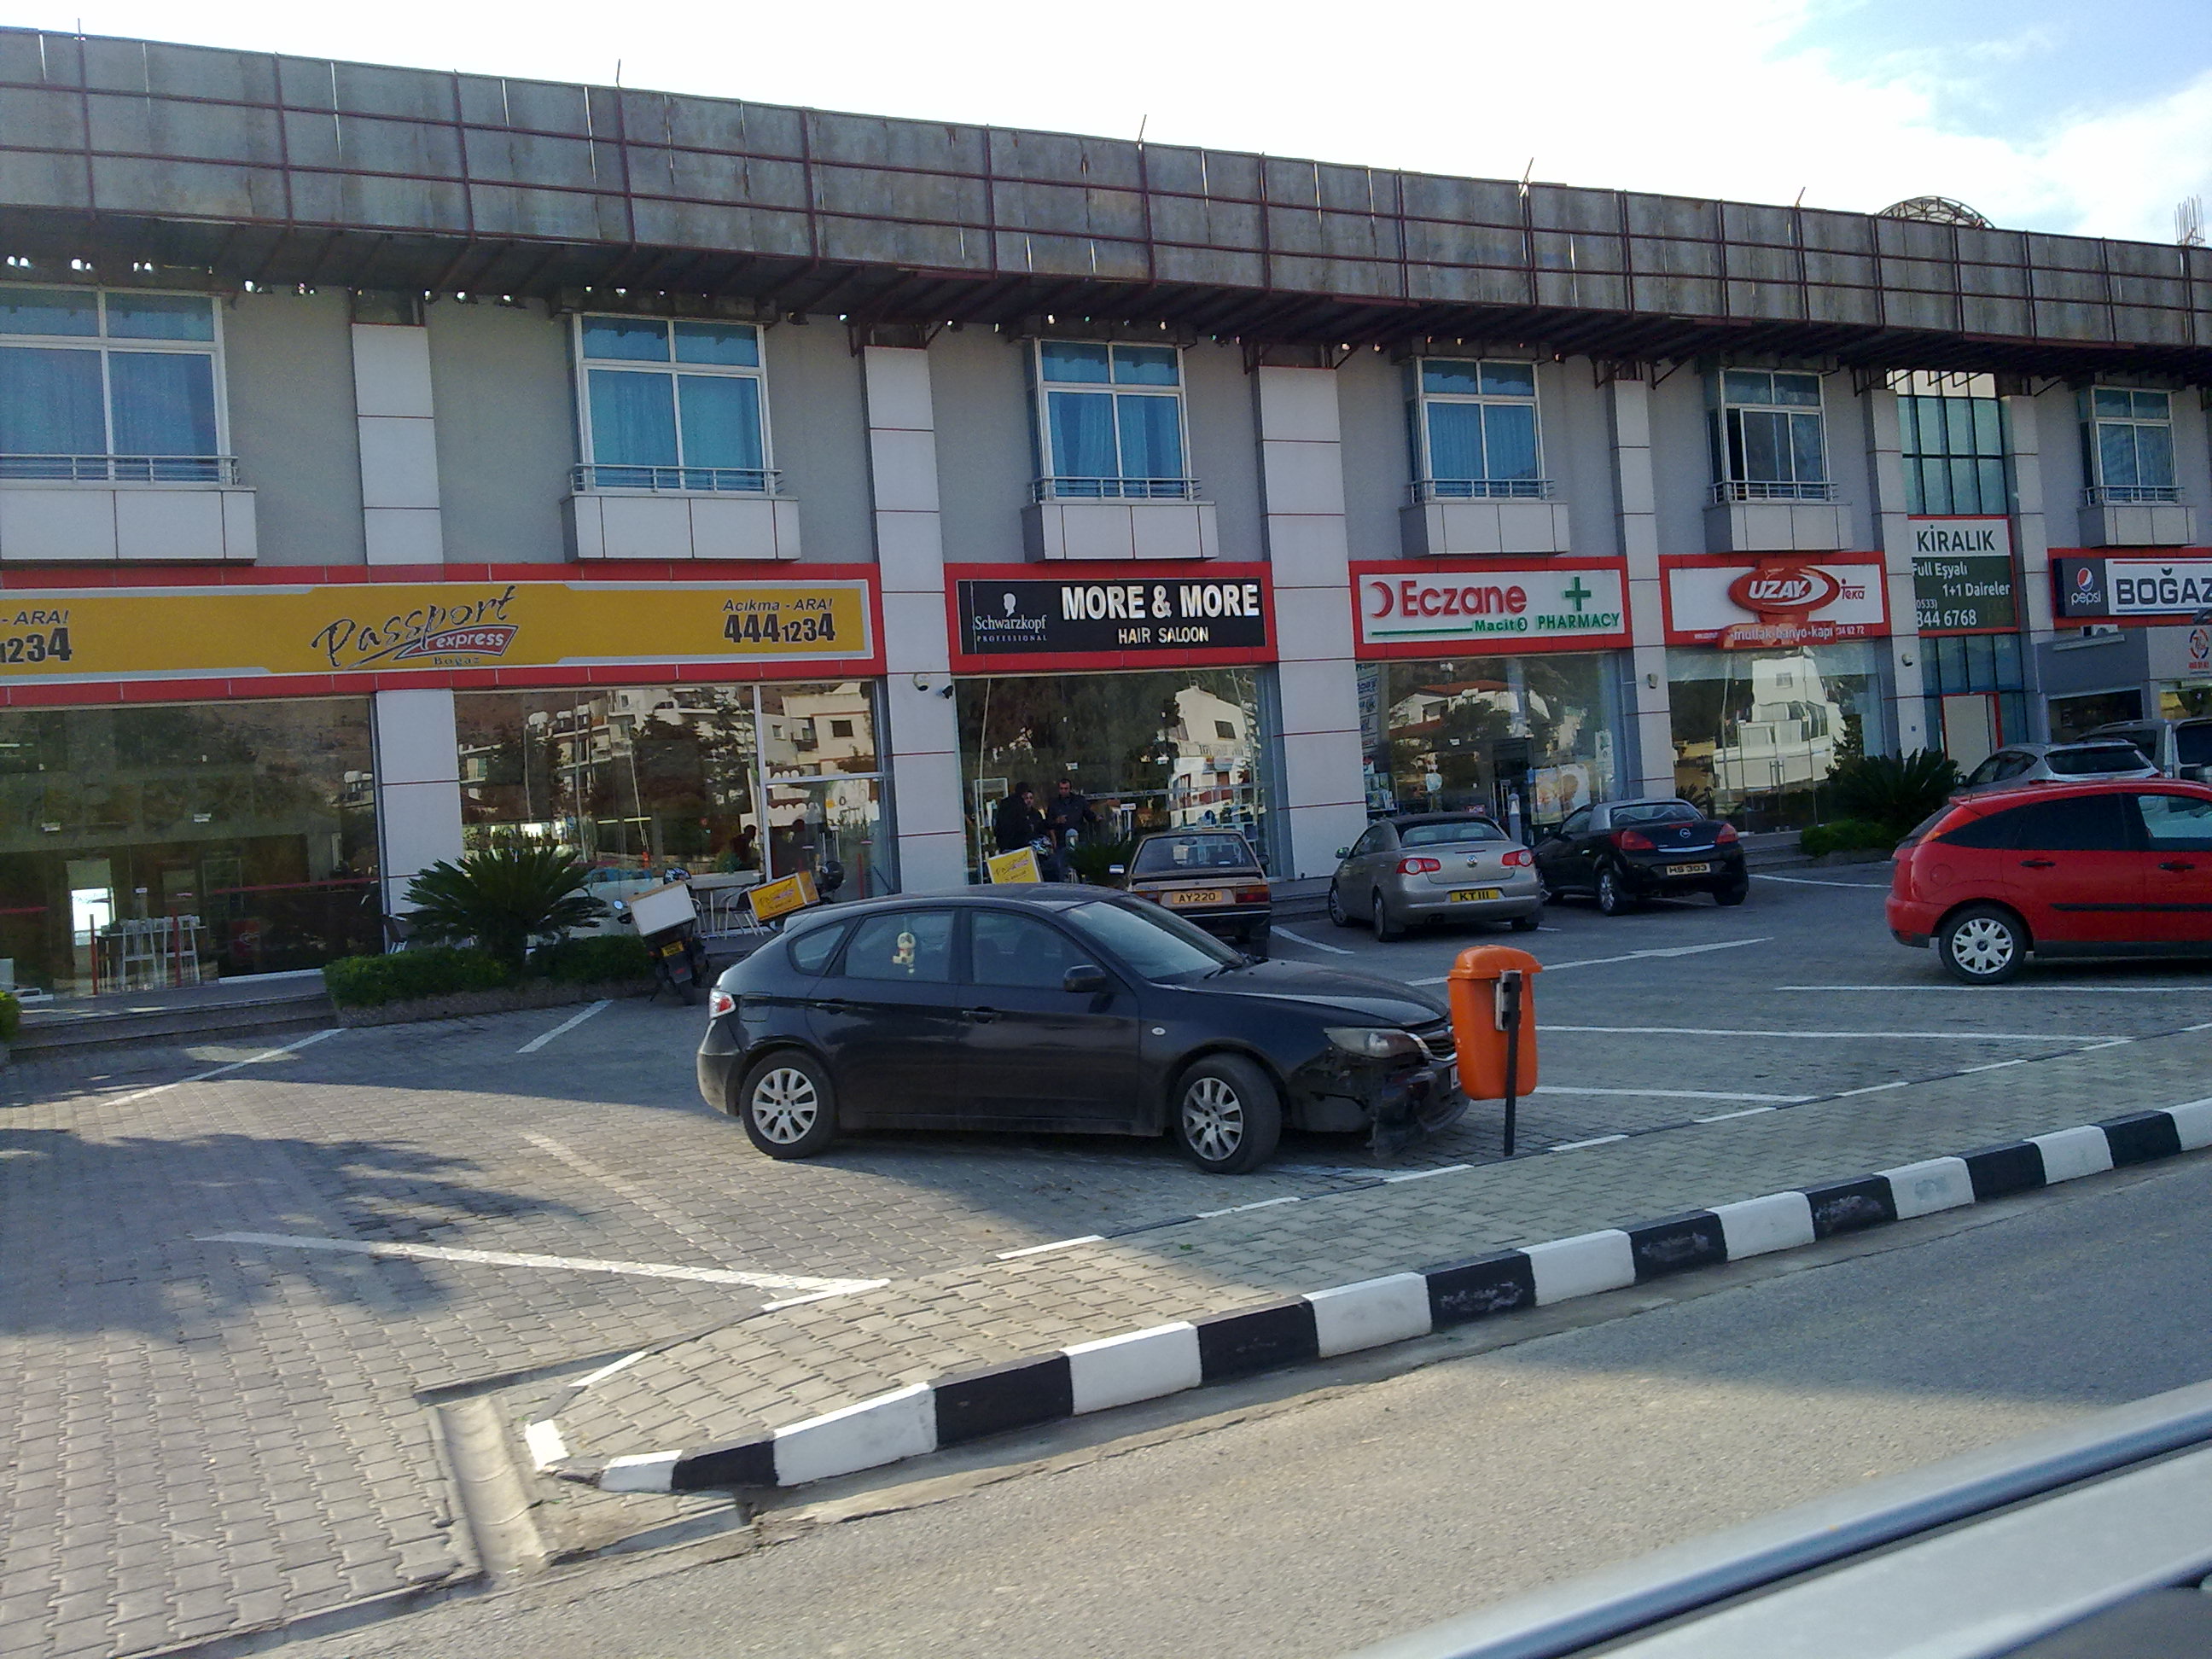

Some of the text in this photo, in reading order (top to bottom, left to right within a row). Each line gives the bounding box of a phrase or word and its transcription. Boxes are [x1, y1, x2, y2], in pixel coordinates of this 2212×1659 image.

[1917, 524, 1995, 552] KİRALIK
[1912, 562, 1968, 579] Full Eşyalı
[1749, 579, 1808, 599] UZAY
[1942, 581, 2011, 597] 1+1 Daireler
[2071, 590, 2101, 606] pepsi
[723, 598, 781, 612] Acıkma
[793, 597, 833, 611] ARA!
[1062, 583, 1260, 620] MORE & MORE
[1400, 580, 1528, 617] Eczane
[12, 608, 69, 626] ARA!
[311, 584, 516, 668] Passport
[975, 614, 1048, 634] Schwarzkopf
[1475, 619, 1514, 632] Macit
[1537, 612, 1621, 630] PHARMACY
[1916, 608, 1977, 628] 844 6768
[435, 632, 505, 649] express
[976, 634, 1048, 643] PROFESSIONAL
[1118, 626, 1210, 644] HAIR SALOON
